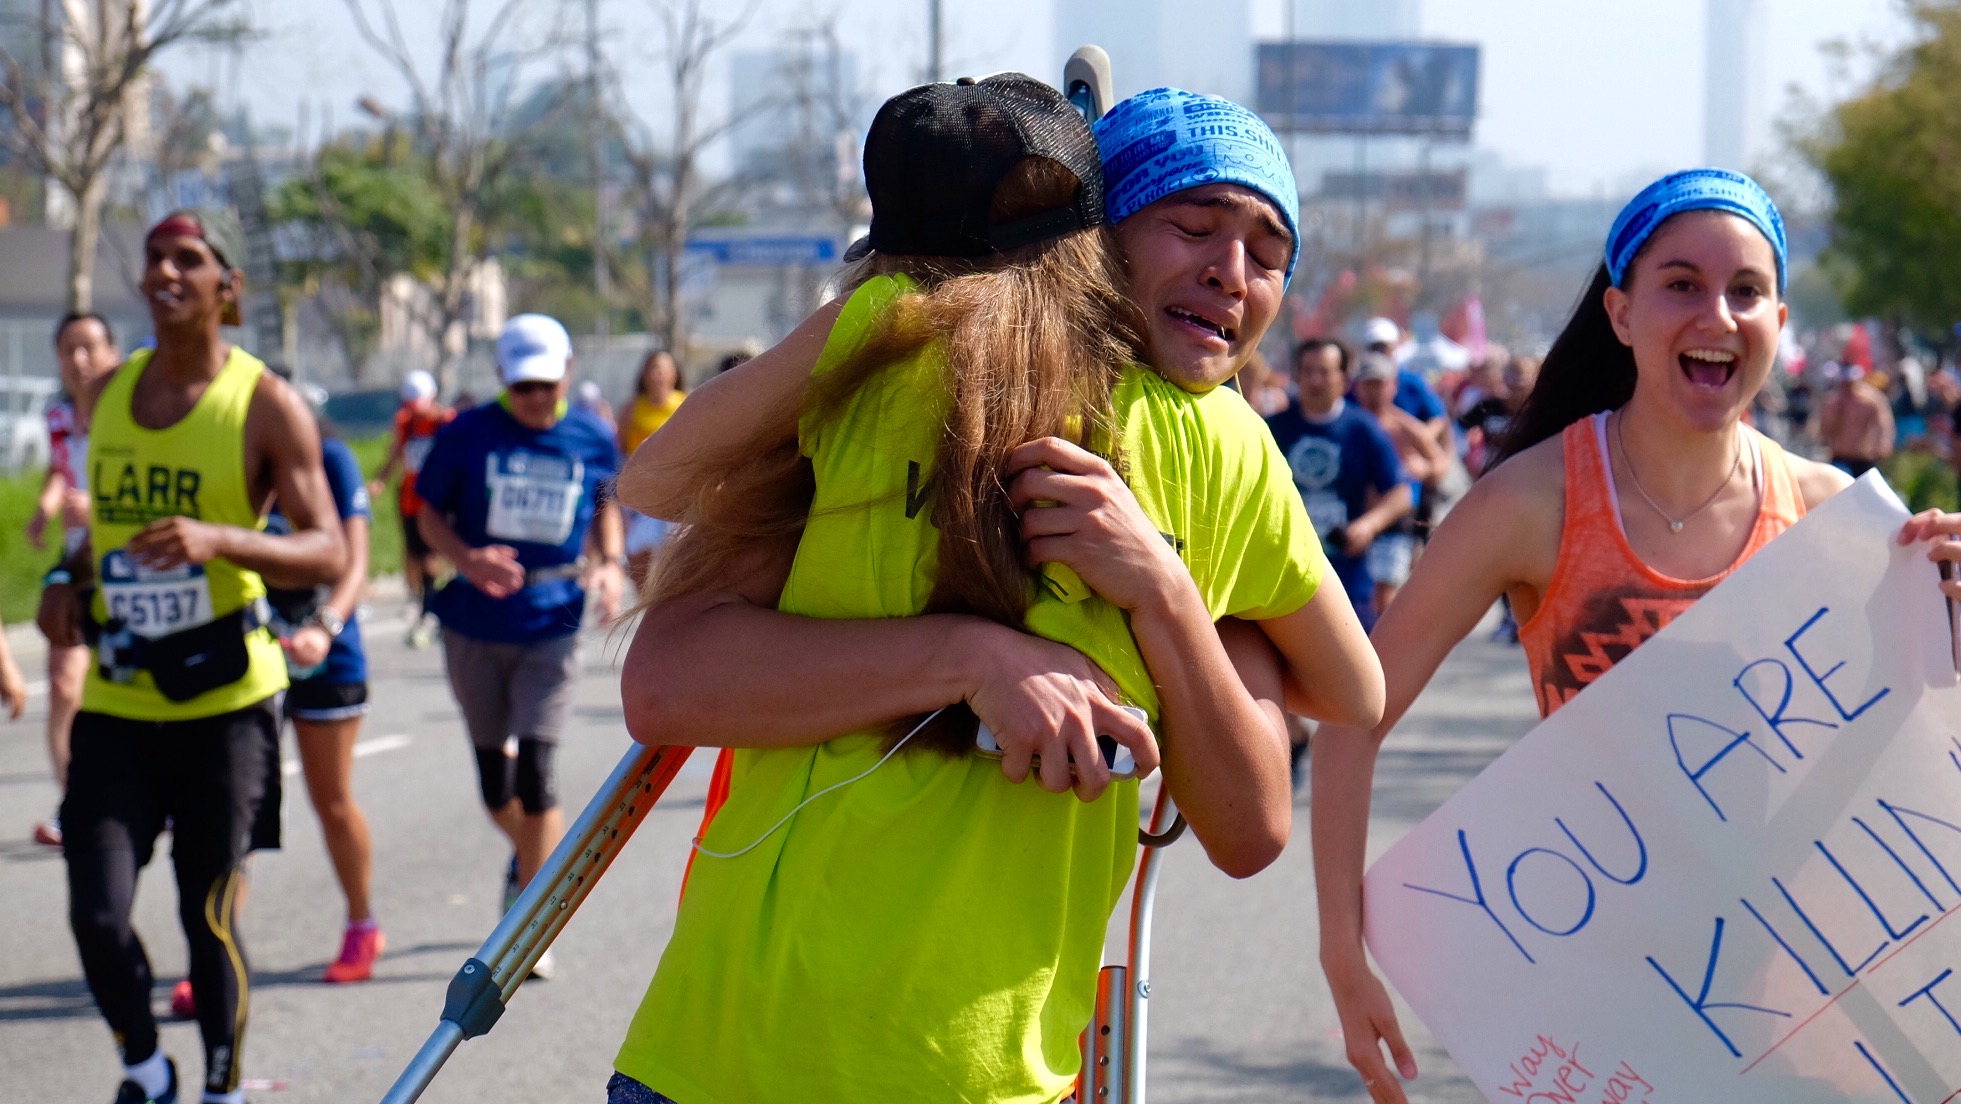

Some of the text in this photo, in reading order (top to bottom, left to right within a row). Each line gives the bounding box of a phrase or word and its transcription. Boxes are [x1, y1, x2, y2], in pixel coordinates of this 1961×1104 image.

[94, 461, 201, 507] LARR
[1402, 606, 1891, 964] YOU ARE
[1644, 738, 1961, 1059] KILLIN
